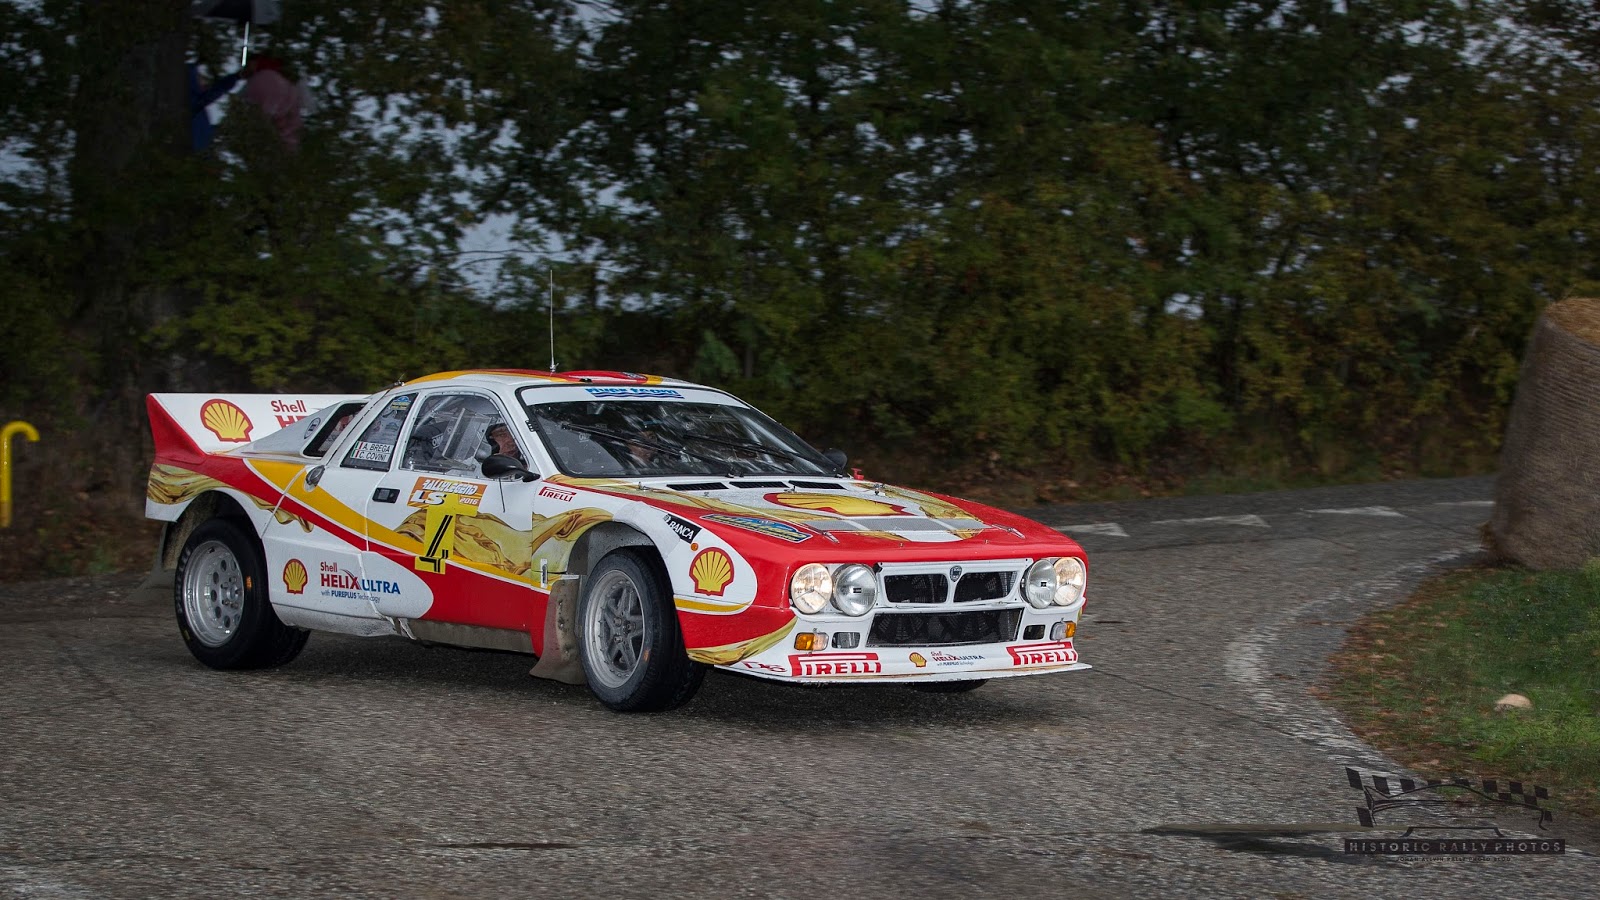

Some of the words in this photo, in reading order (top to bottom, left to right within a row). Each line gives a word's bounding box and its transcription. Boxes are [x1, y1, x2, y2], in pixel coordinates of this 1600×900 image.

[271, 400, 307, 413] Shell
[362, 443, 368, 451] A.
[370, 443, 391, 453] BREGA
[359, 451, 365, 459] C.
[366, 452, 387, 461] COVINI
[459, 497, 479, 505] 2016
[538, 486, 577, 502] PIRELLI
[668, 520, 695, 540] BANCA
[419, 514, 453, 573] 4
[320, 561, 338, 573] Shell
[320, 573, 362, 591] HELIX
[361, 578, 401, 595] ULTRA
[331, 590, 357, 599] PUREPLUS
[1006, 641, 1078, 666] PIRELLI
[788, 652, 882, 677] PIRELLI
